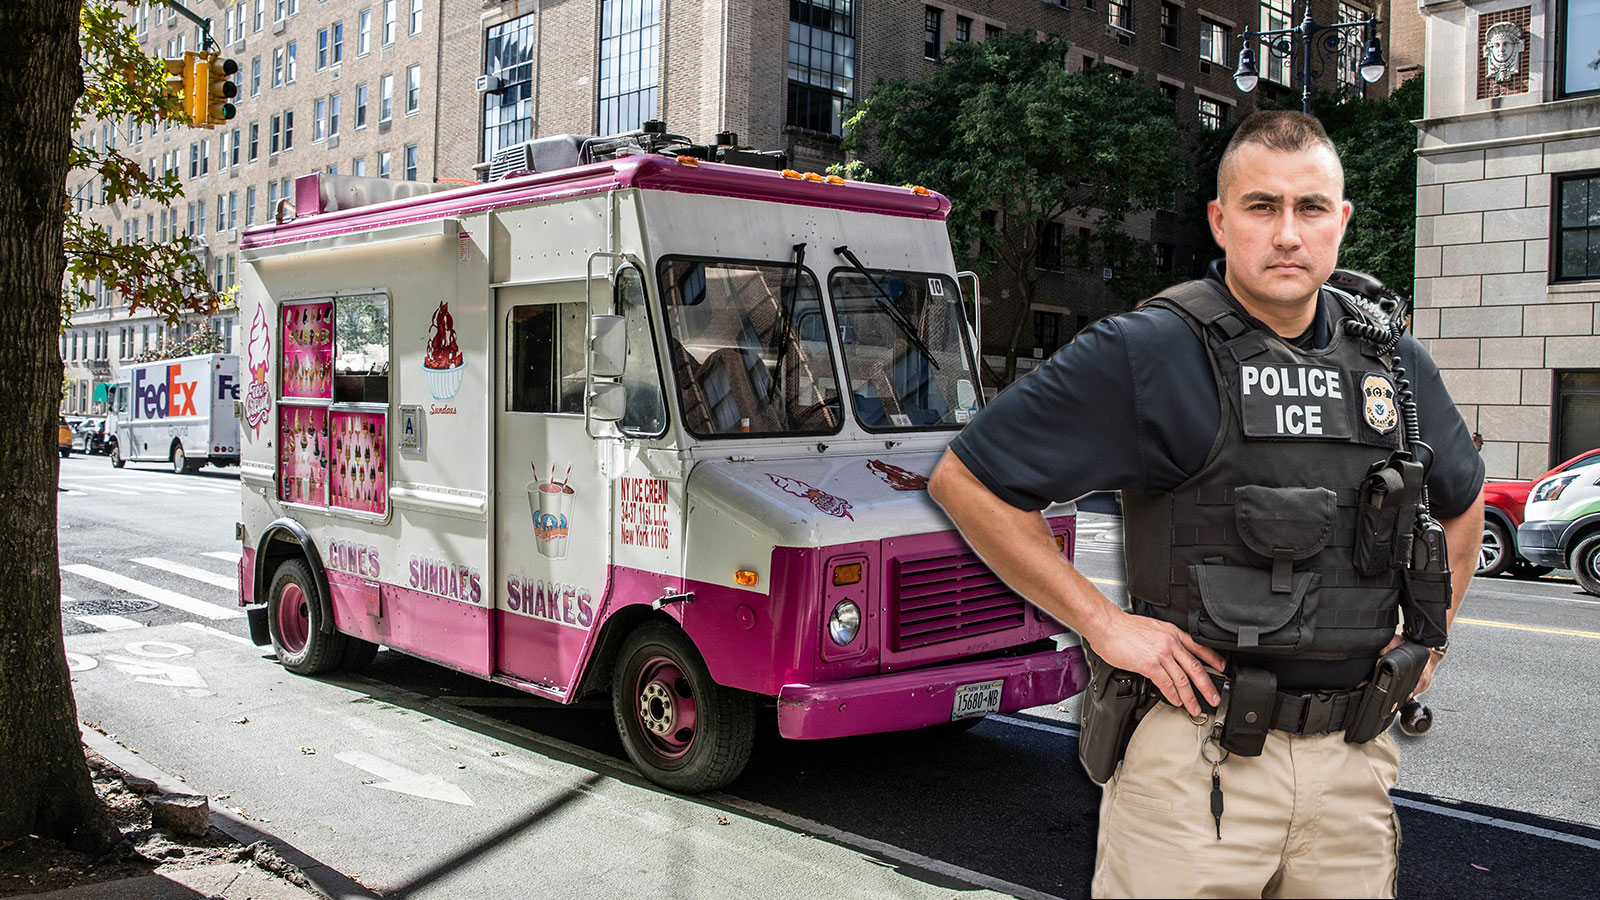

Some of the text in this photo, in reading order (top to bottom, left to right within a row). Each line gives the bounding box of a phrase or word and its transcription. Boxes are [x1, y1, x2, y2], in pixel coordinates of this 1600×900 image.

[930, 279, 942, 295] 10
[135, 364, 198, 419] FedEx
[1241, 365, 1343, 399] POLICE
[405, 417, 414, 435] A
[1275, 404, 1322, 435] ICE
[620, 477, 669, 505] NY ICE CREAM
[620, 501, 637, 524] 34-37
[620, 523, 669, 550] New York 11106
[328, 536, 381, 579] CONES
[408, 553, 482, 604] SUNDAES
[506, 573, 593, 628] SHAKES
